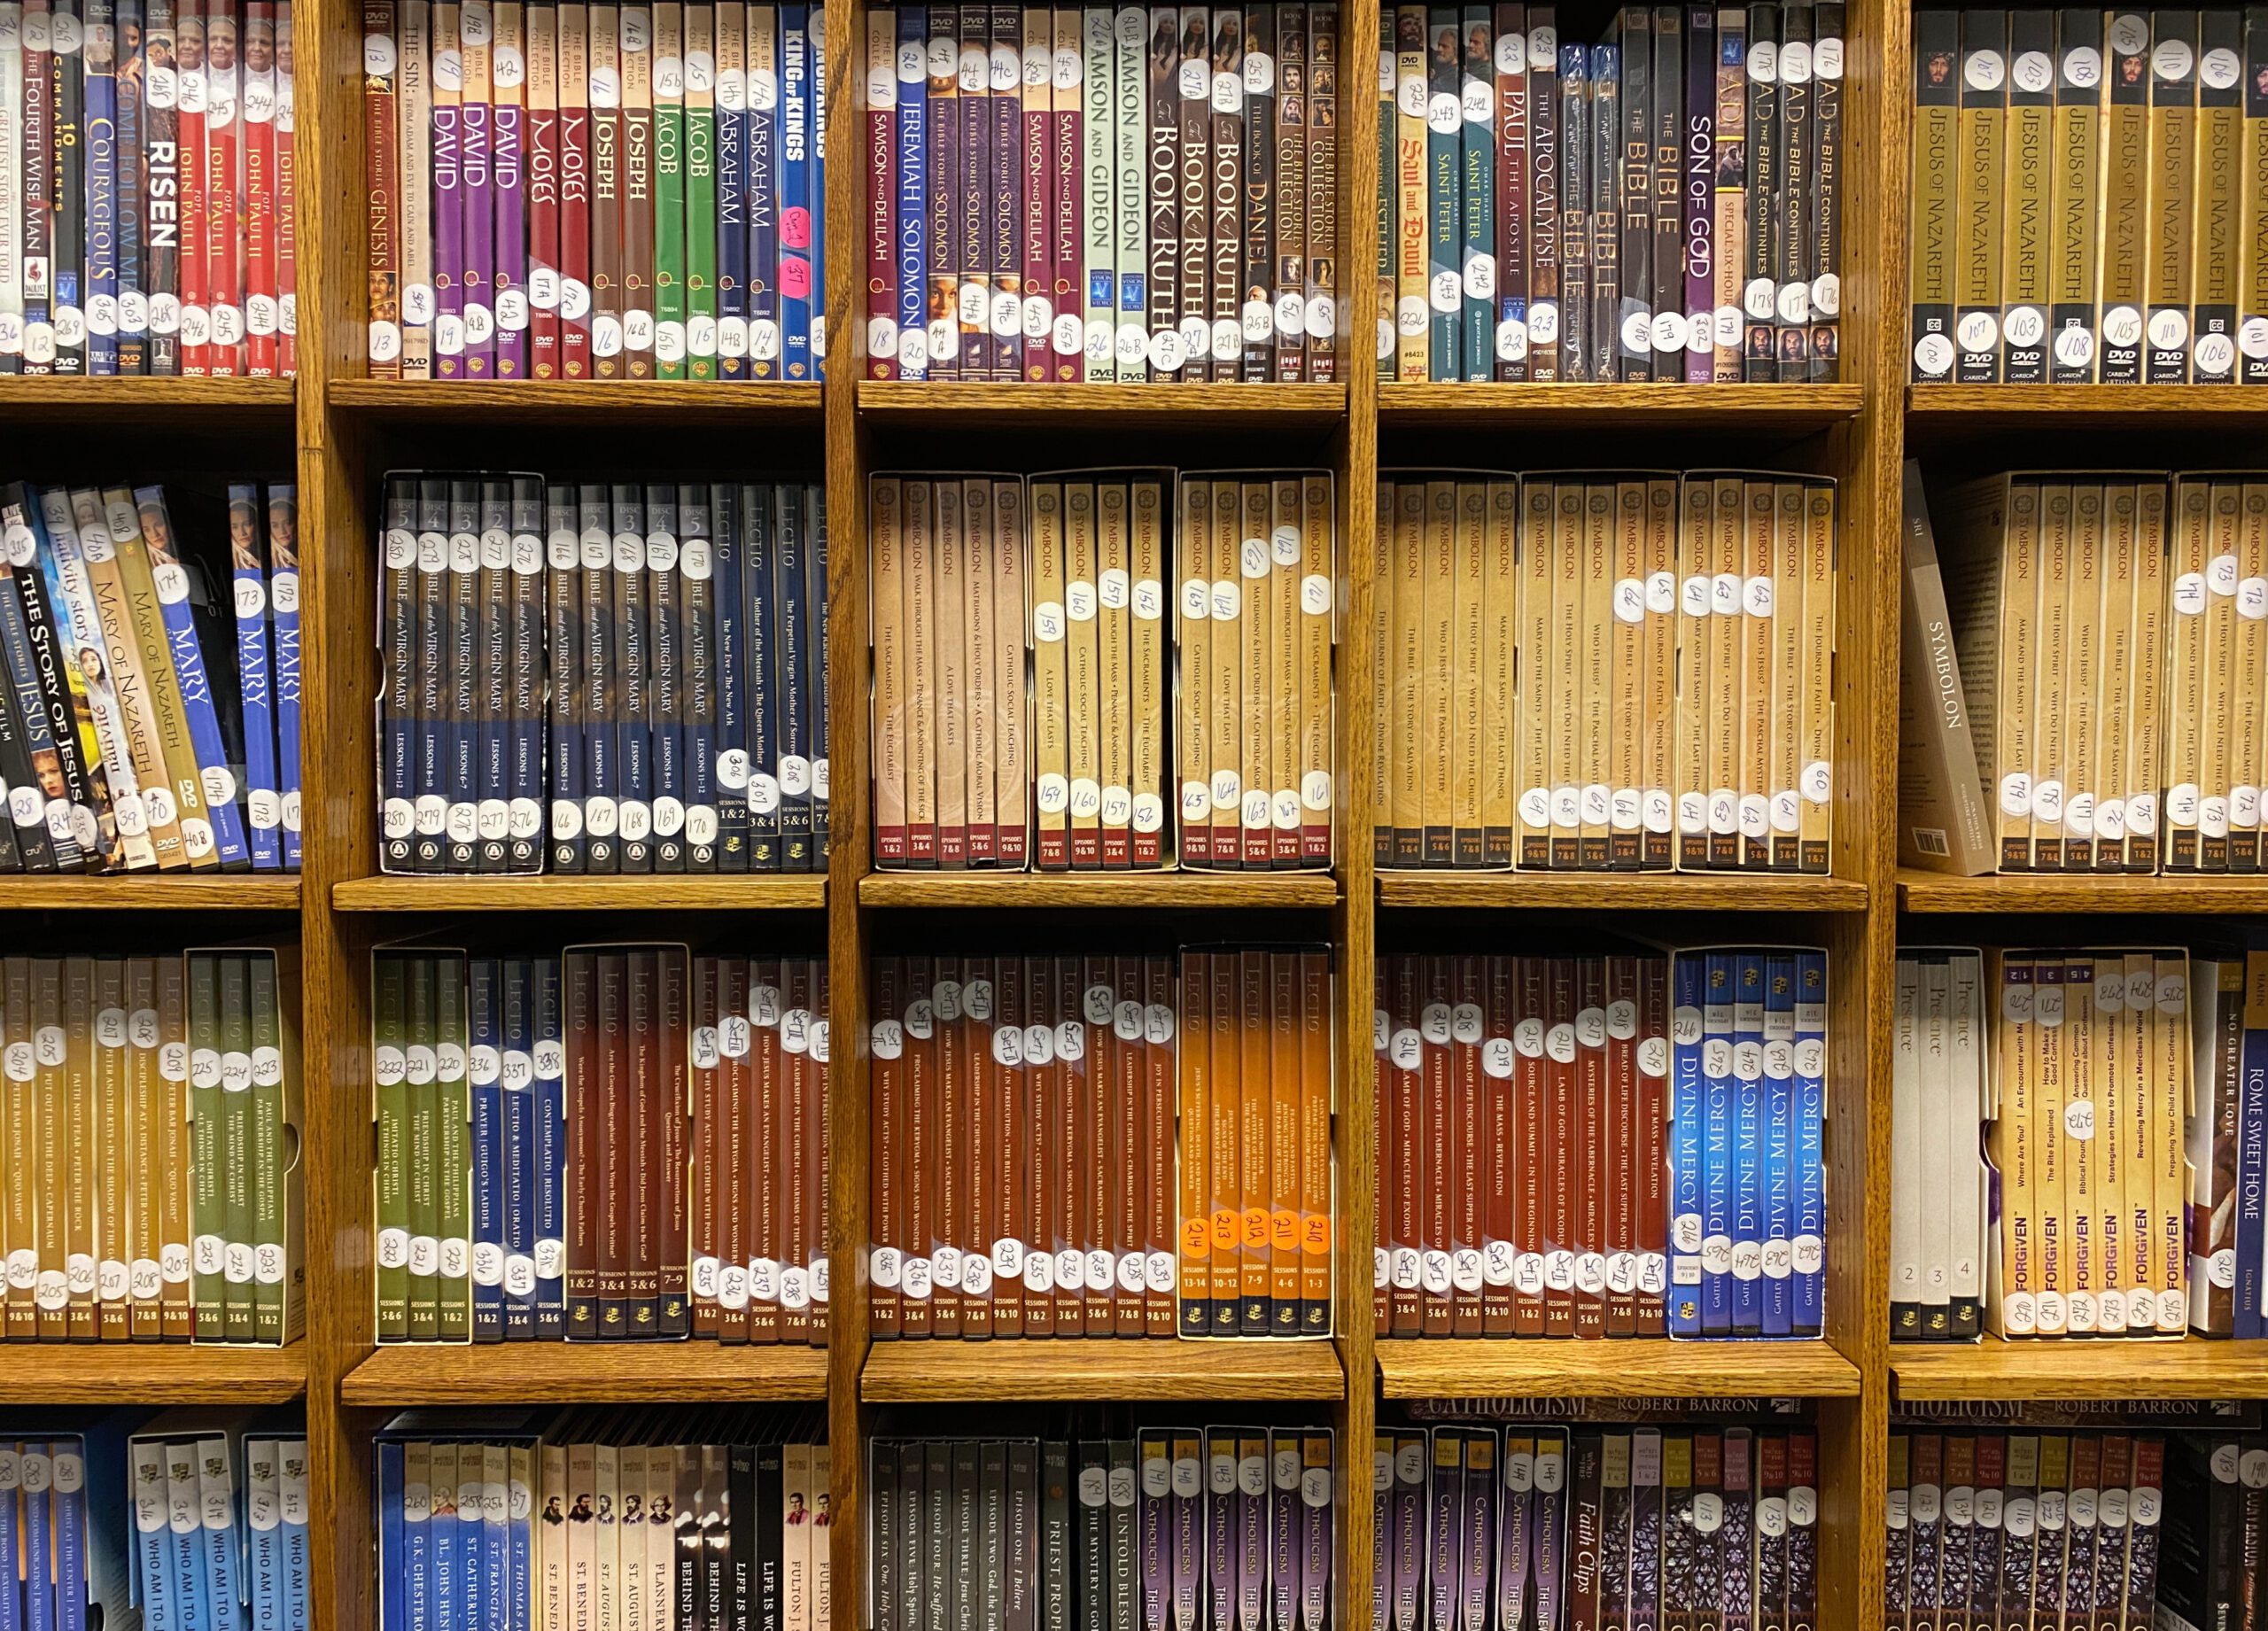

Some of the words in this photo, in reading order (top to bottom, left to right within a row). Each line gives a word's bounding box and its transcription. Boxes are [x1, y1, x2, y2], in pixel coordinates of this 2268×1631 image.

[28, 51, 37, 76] THE
[404, 24, 418, 56] THE
[785, 29, 804, 81] KING
[26, 77, 43, 151] FOURTH
[245, 95, 273, 114] 244
[1502, 89, 1526, 157] PAUL
[1539, 91, 1548, 120] THE
[1755, 82, 1775, 121] A.D.
[53, 56, 63, 212] COMMANDMENTS
[62, 122, 75, 147] 10
[434, 109, 456, 190] DAVID
[687, 111, 711, 177] JACOB
[786, 97, 804, 161] KINGS
[874, 114, 887, 175] SAMSON
[899, 102, 921, 201] JEREMIAH
[1122, 134, 1134, 161] AND
[1688, 115, 1711, 175] SON
[2022, 108, 2040, 172] JESUS
[247, 149, 262, 194] JOHN
[562, 116, 586, 203] MOSES
[625, 110, 649, 199] JOSEPH
[721, 109, 741, 223] ABRAHAM
[1402, 138, 1423, 194] Saul
[1469, 150, 1481, 191] SAINT
[1509, 159, 1519, 194] THE
[1758, 146, 1770, 196] BIBLE
[27, 156, 43, 202] WISE
[89, 117, 116, 280] COURAGEOUS
[150, 141, 176, 247] RISEN
[408, 192, 415, 204] TO
[877, 176, 887, 201] AND
[1184, 141, 1207, 223] BOOK
[1534, 125, 1555, 269] APOCALYPSE
[1688, 179, 1706, 211] OF
[2022, 174, 2037, 193] OF
[249, 202, 262, 245] PAUL
[261, 191, 270, 215] POPE
[1122, 169, 1140, 252] GIDEON
[1247, 180, 1268, 271] DANIEL
[1469, 198, 1480, 240] PETER
[27, 206, 43, 251] MAN
[370, 189, 388, 268] GENESIS
[874, 200, 887, 261] DELILAH
[1403, 215, 1424, 278] David
[1509, 200, 1519, 276] APOSTLE
[1687, 217, 1710, 278] GOD
[1757, 198, 1769, 274] CONTINUES
[2019, 198, 2038, 300] NAZARETH
[248, 248, 262, 258] II
[787, 265, 804, 284] 37
[903, 219, 921, 328] SOLOMON
[1184, 237, 1207, 317] RUTH
[32, 337, 48, 353] 12
[1963, 353, 1992, 363] DVD
[2202, 343, 2227, 362] 106
[750, 507, 763, 569] LECTIO
[1043, 516, 1052, 579] SYMBOLON
[1499, 514, 1509, 576] SYMBOLON
[1787, 516, 1797, 577] SYMBOLON
[19, 574, 42, 623] THE
[96, 581, 121, 640] MARY
[237, 591, 258, 608] 173
[557, 574, 569, 608] BIBLE
[70, 597, 92, 643] story
[30, 625, 60, 696] STORY
[113, 645, 128, 669] OF
[242, 625, 267, 708] MARY
[558, 637, 570, 680] VIRGIN
[1929, 620, 1961, 729] SYMBOLON
[51, 702, 68, 734] OF
[559, 682, 570, 716] MARY
[118, 675, 153, 773] NAZARETH
[56, 736, 84, 803] JESUS
[1406, 744, 1415, 792] SALVATION
[1816, 769, 1829, 789] 60
[1074, 791, 1097, 807] 160
[1930, 988, 1946, 1055] Presence
[2228, 1014, 2237, 1030] NO
[2225, 1037, 2237, 1097] GREATER
[1682, 1057, 1697, 1130] DIVINE
[2248, 1068, 2264, 1115] ROME
[479, 1097, 488, 1136] PRAYER
[1802, 1080, 1818, 1151] MERCY
[2225, 1102, 2234, 1136] LOVE
[2247, 1120, 2262, 1168] SWEET
[1682, 1137, 1697, 1209] MERCY
[1802, 1158, 1817, 1231] DIVINE
[2244, 1172, 2260, 1220] HOME
[481, 1185, 490, 1229] LADDER
[1216, 1214, 1231, 1239] 213
[1246, 1215, 1265, 1240] 212
[1187, 1223, 1204, 1248] 214
[1306, 1220, 1323, 1243] 210
[1905, 1267, 1914, 1281] 2
[1934, 1270, 1942, 1283] 3
[1961, 1262, 1969, 1274] 4
[1689, 1399, 1759, 1412] BARRON
[1014, 1490, 1023, 1536] EPISODE
[1216, 1495, 1227, 1574] CATHOLICISM
[1580, 1502, 1596, 1547] Faith
[258, 1537, 270, 1567] WHO
[1117, 1512, 1129, 1578] UNTOLD
[260, 1572, 272, 1593] AM
[437, 1560, 450, 1591] JOHN
[682, 1561, 693, 1613] BEHIND
[764, 1561, 774, 1594] LIFE
[790, 1561, 802, 1614] FULTON
[1573, 1550, 1596, 1595] Clips
[764, 1597, 773, 1612] IS
[1216, 1586, 1226, 1608] THE
